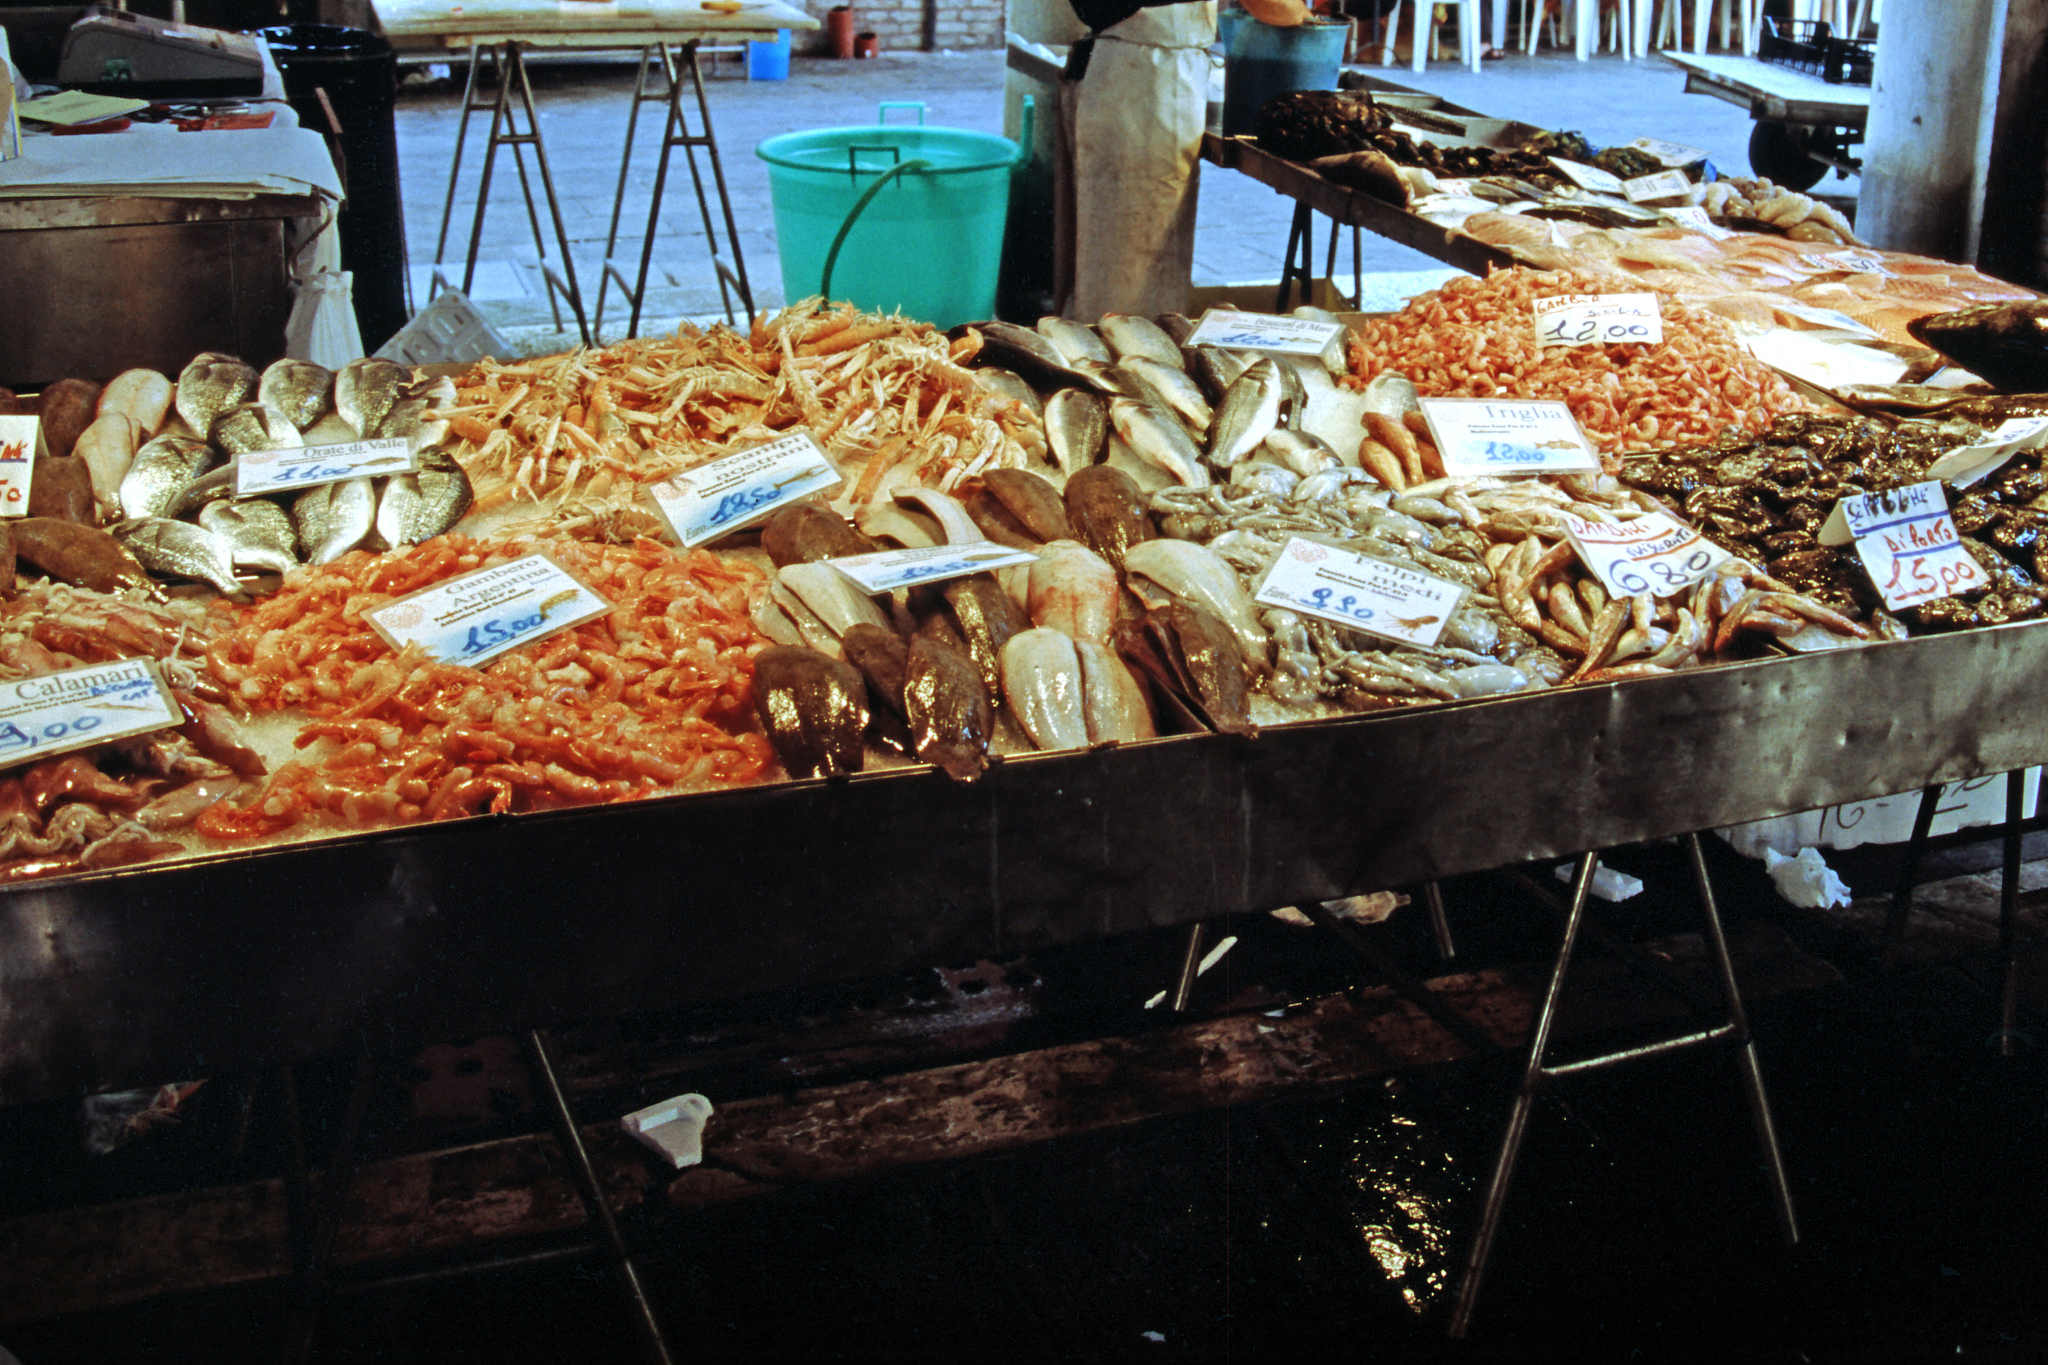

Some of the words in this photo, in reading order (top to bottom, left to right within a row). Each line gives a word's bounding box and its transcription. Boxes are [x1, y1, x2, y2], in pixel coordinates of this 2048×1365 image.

[1296, 320, 1307, 329] di
[1307, 322, 1334, 333] Mare
[1544, 319, 1649, 342] 12,00
[1478, 404, 1563, 422] Triglia
[303, 444, 346, 458] Orate
[348, 440, 363, 454] di
[368, 438, 406, 450] Valle
[711, 436, 801, 471] Scampi
[716, 441, 811, 481] nostrani
[686, 525, 707, 541] Euro
[445, 559, 540, 594] Gambero
[1354, 556, 1428, 586] Folpi
[453, 567, 551, 607] Argentina
[1262, 586, 1290, 599] Euro
[1372, 575, 1443, 602] medi
[15, 661, 144, 700] Calamari
